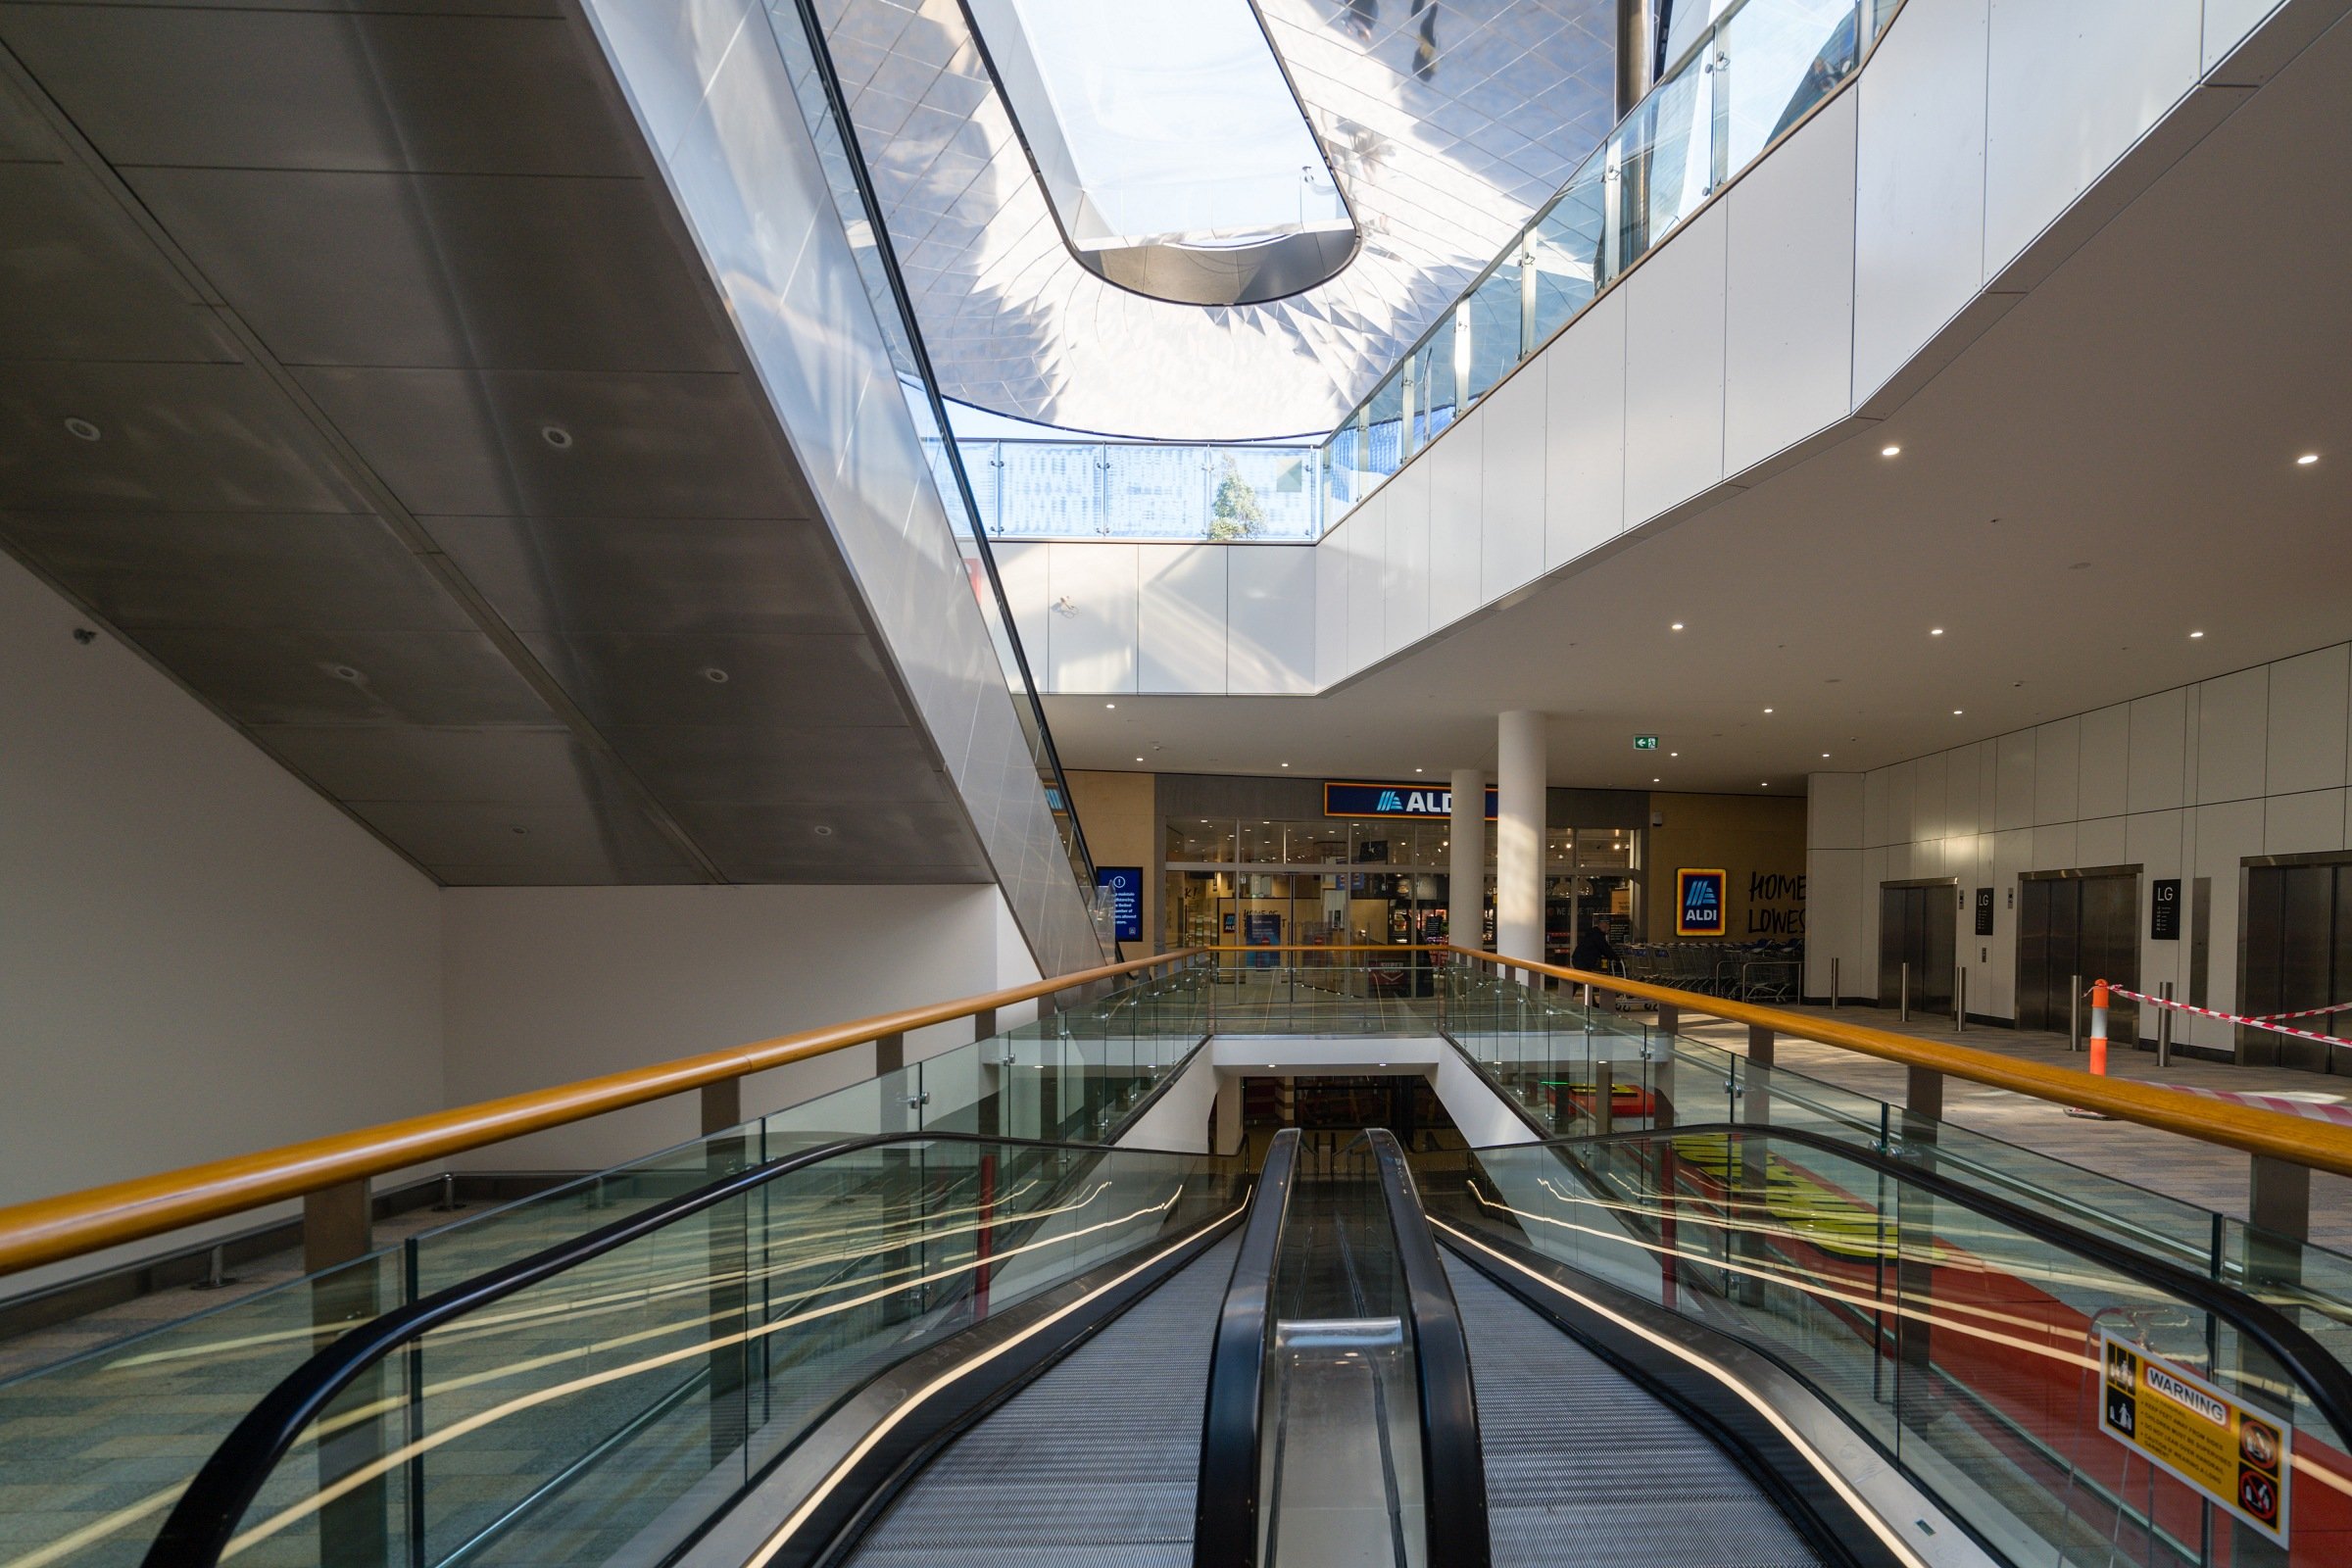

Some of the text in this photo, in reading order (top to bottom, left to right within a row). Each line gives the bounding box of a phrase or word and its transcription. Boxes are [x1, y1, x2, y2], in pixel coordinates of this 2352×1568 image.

[1405, 791, 1451, 813] ALD
[1748, 871, 1806, 902] HOME
[1979, 894, 1989, 906] LG
[2157, 886, 2174, 902] LG
[1686, 908, 1717, 921] ALDI
[1748, 907, 1805, 934] LOWES
[2150, 1370, 2223, 1421] WARNING
[2145, 1401, 2224, 1449] KEEP FEET AWAY FROM SIDES
[2145, 1412, 2171, 1431] CHILDREN
[2172, 1428, 2186, 1440] MUST
[2197, 1443, 2232, 1466] SUPERVISED
[2145, 1440, 2169, 1458] GARMENT
[2145, 1433, 2168, 1450] CAUTION
[2175, 1451, 2199, 1470] WEARING
[2206, 1470, 2222, 1484] LONG
[2154, 1428, 2164, 1438] NOT
[2165, 1435, 2179, 1446] LEAN
[2180, 1444, 2194, 1455] OVER
[2196, 1453, 2224, 1473] HANDRAIL
